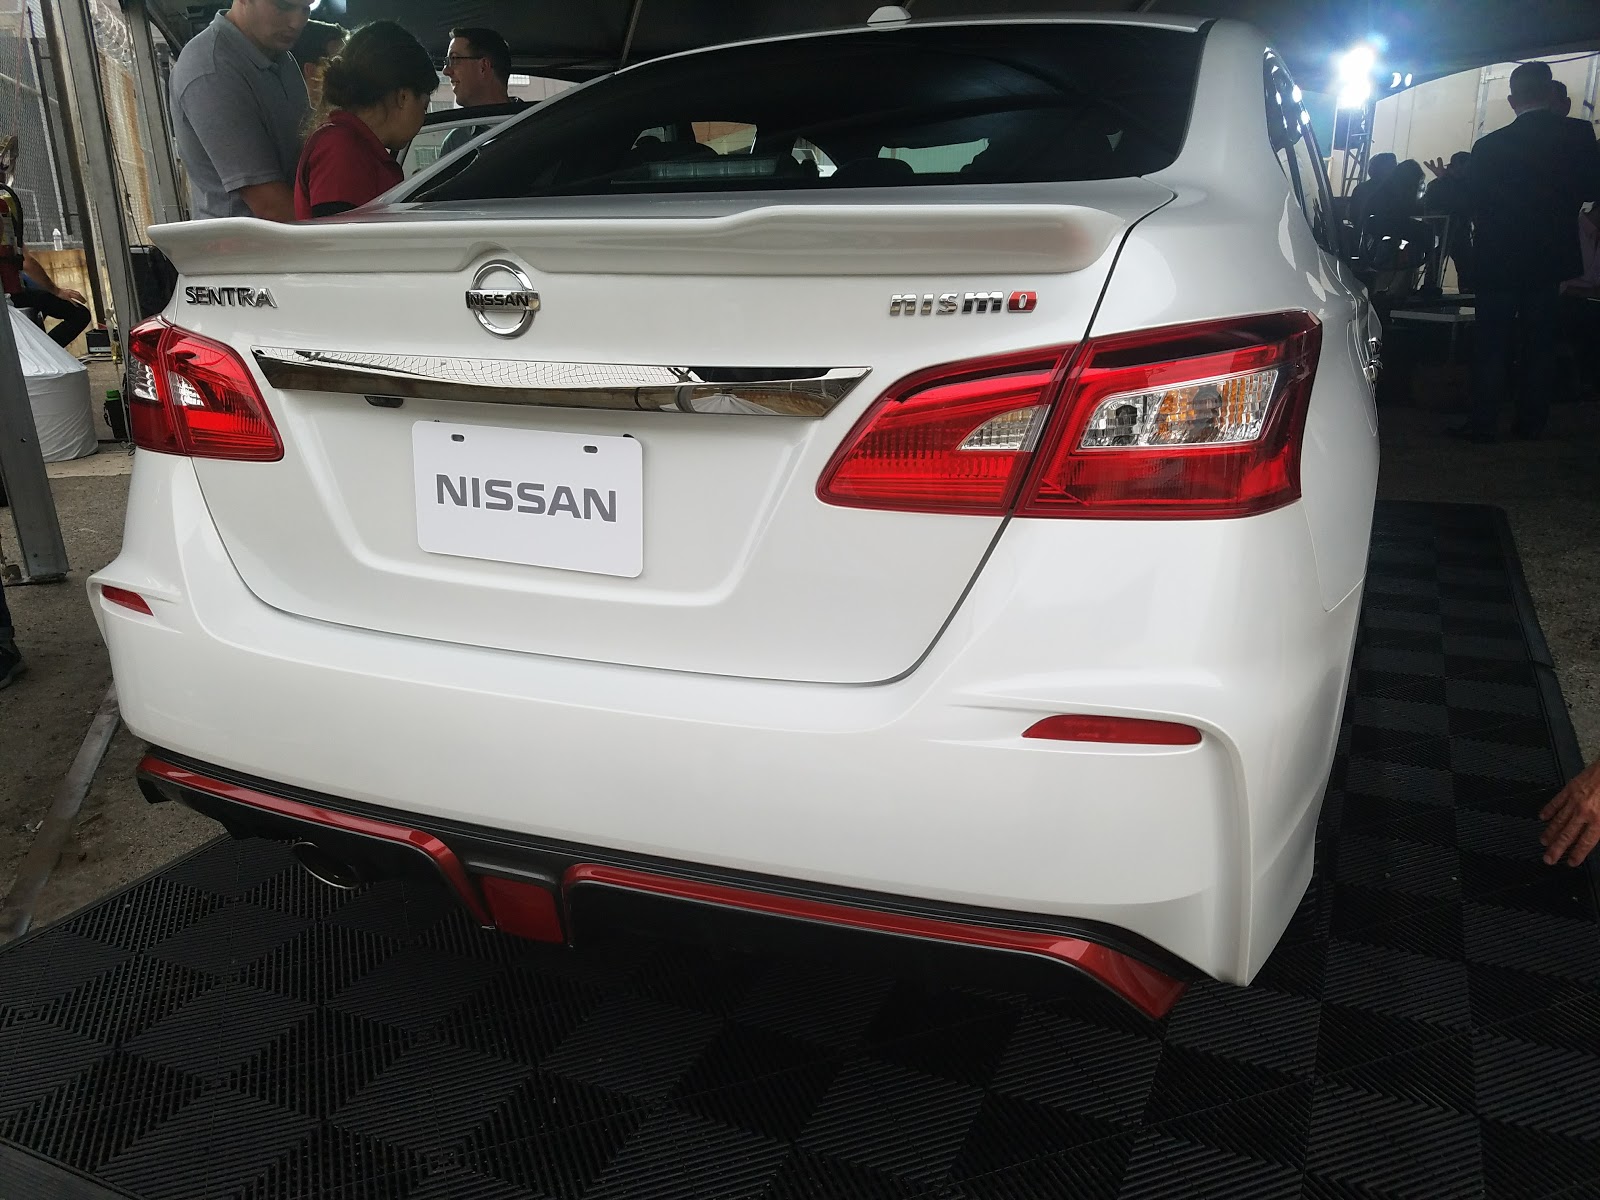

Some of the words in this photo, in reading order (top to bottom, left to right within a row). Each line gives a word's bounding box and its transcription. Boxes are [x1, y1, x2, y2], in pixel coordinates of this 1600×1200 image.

[185, 286, 278, 308] SENTRA
[469, 294, 529, 306] NISSAN
[436, 474, 616, 522] NISSAN
